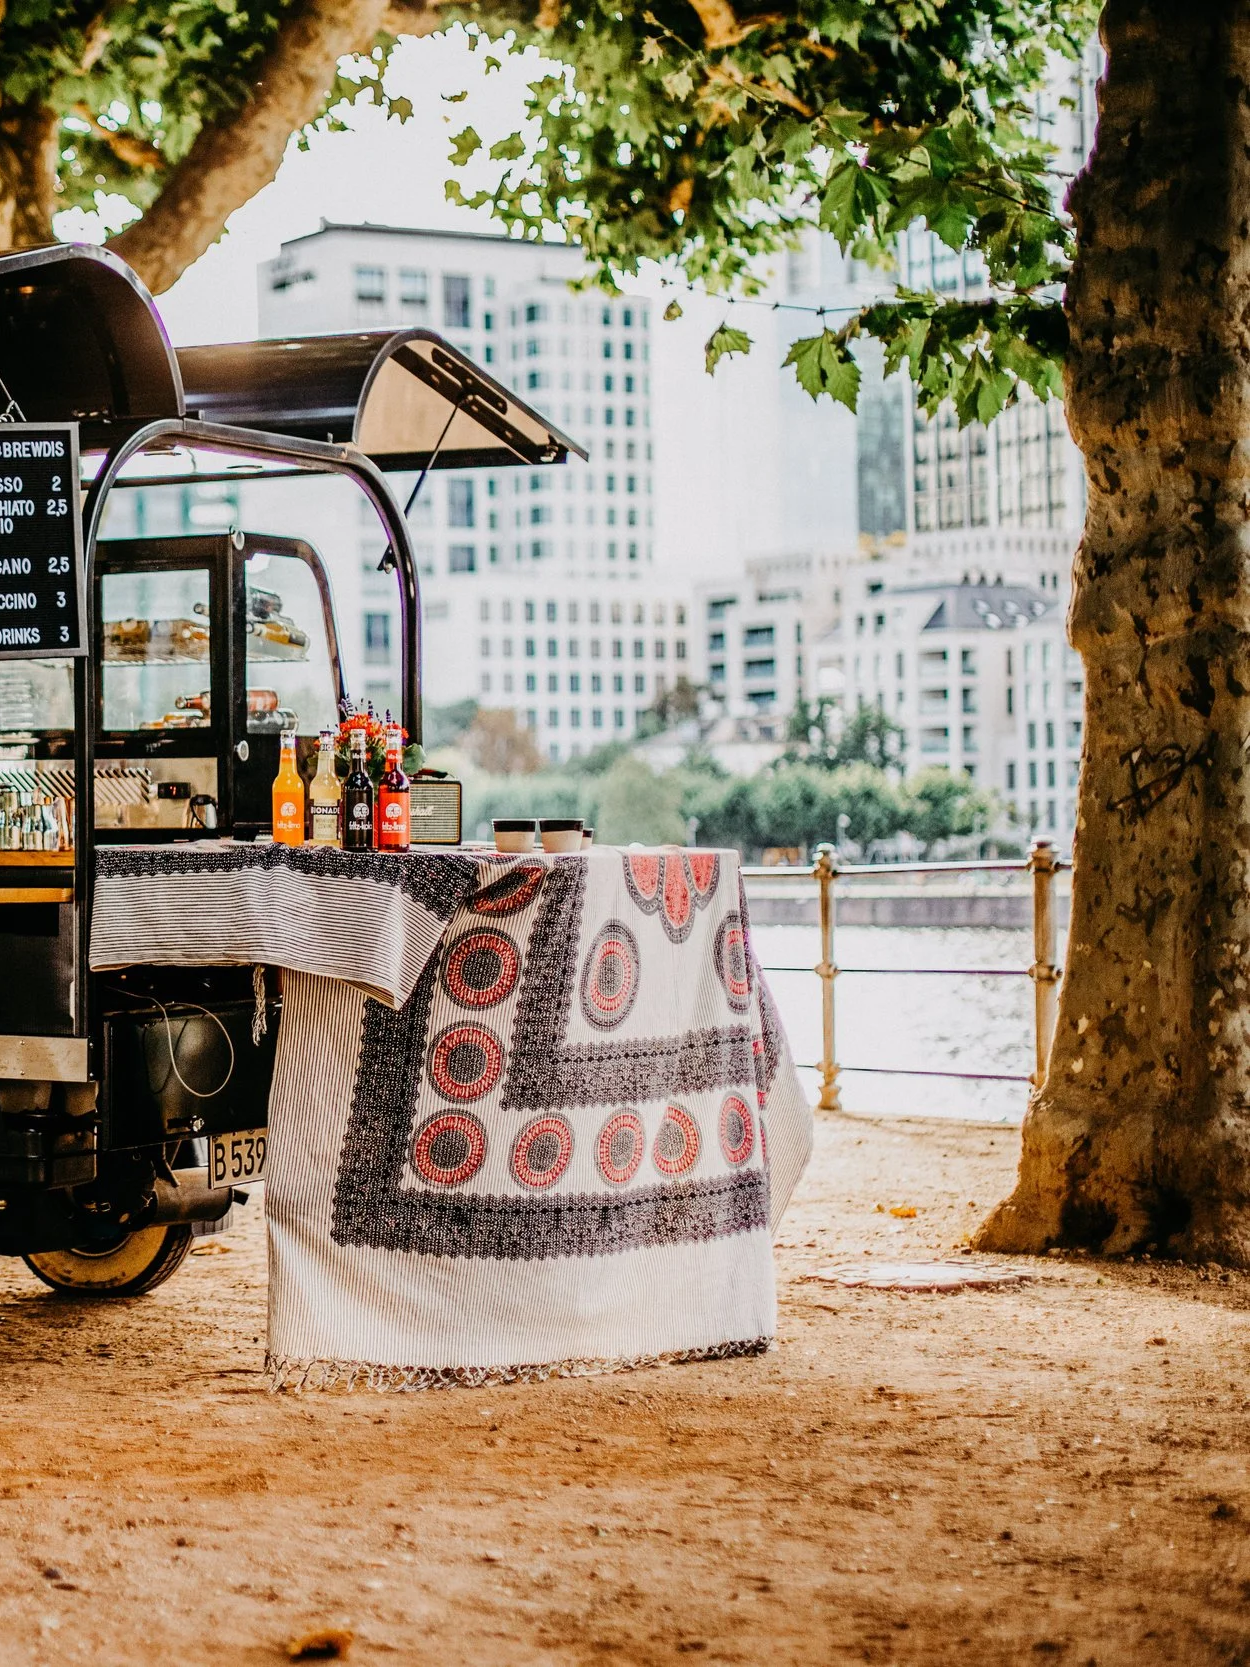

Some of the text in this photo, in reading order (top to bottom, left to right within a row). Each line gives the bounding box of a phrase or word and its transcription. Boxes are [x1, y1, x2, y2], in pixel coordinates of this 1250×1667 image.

[51, 475, 62, 492] 2
[46, 499, 68, 517] 2,5
[48, 557, 70, 575] 2,5
[56, 591, 67, 608] 3
[59, 626, 70, 643] 3
